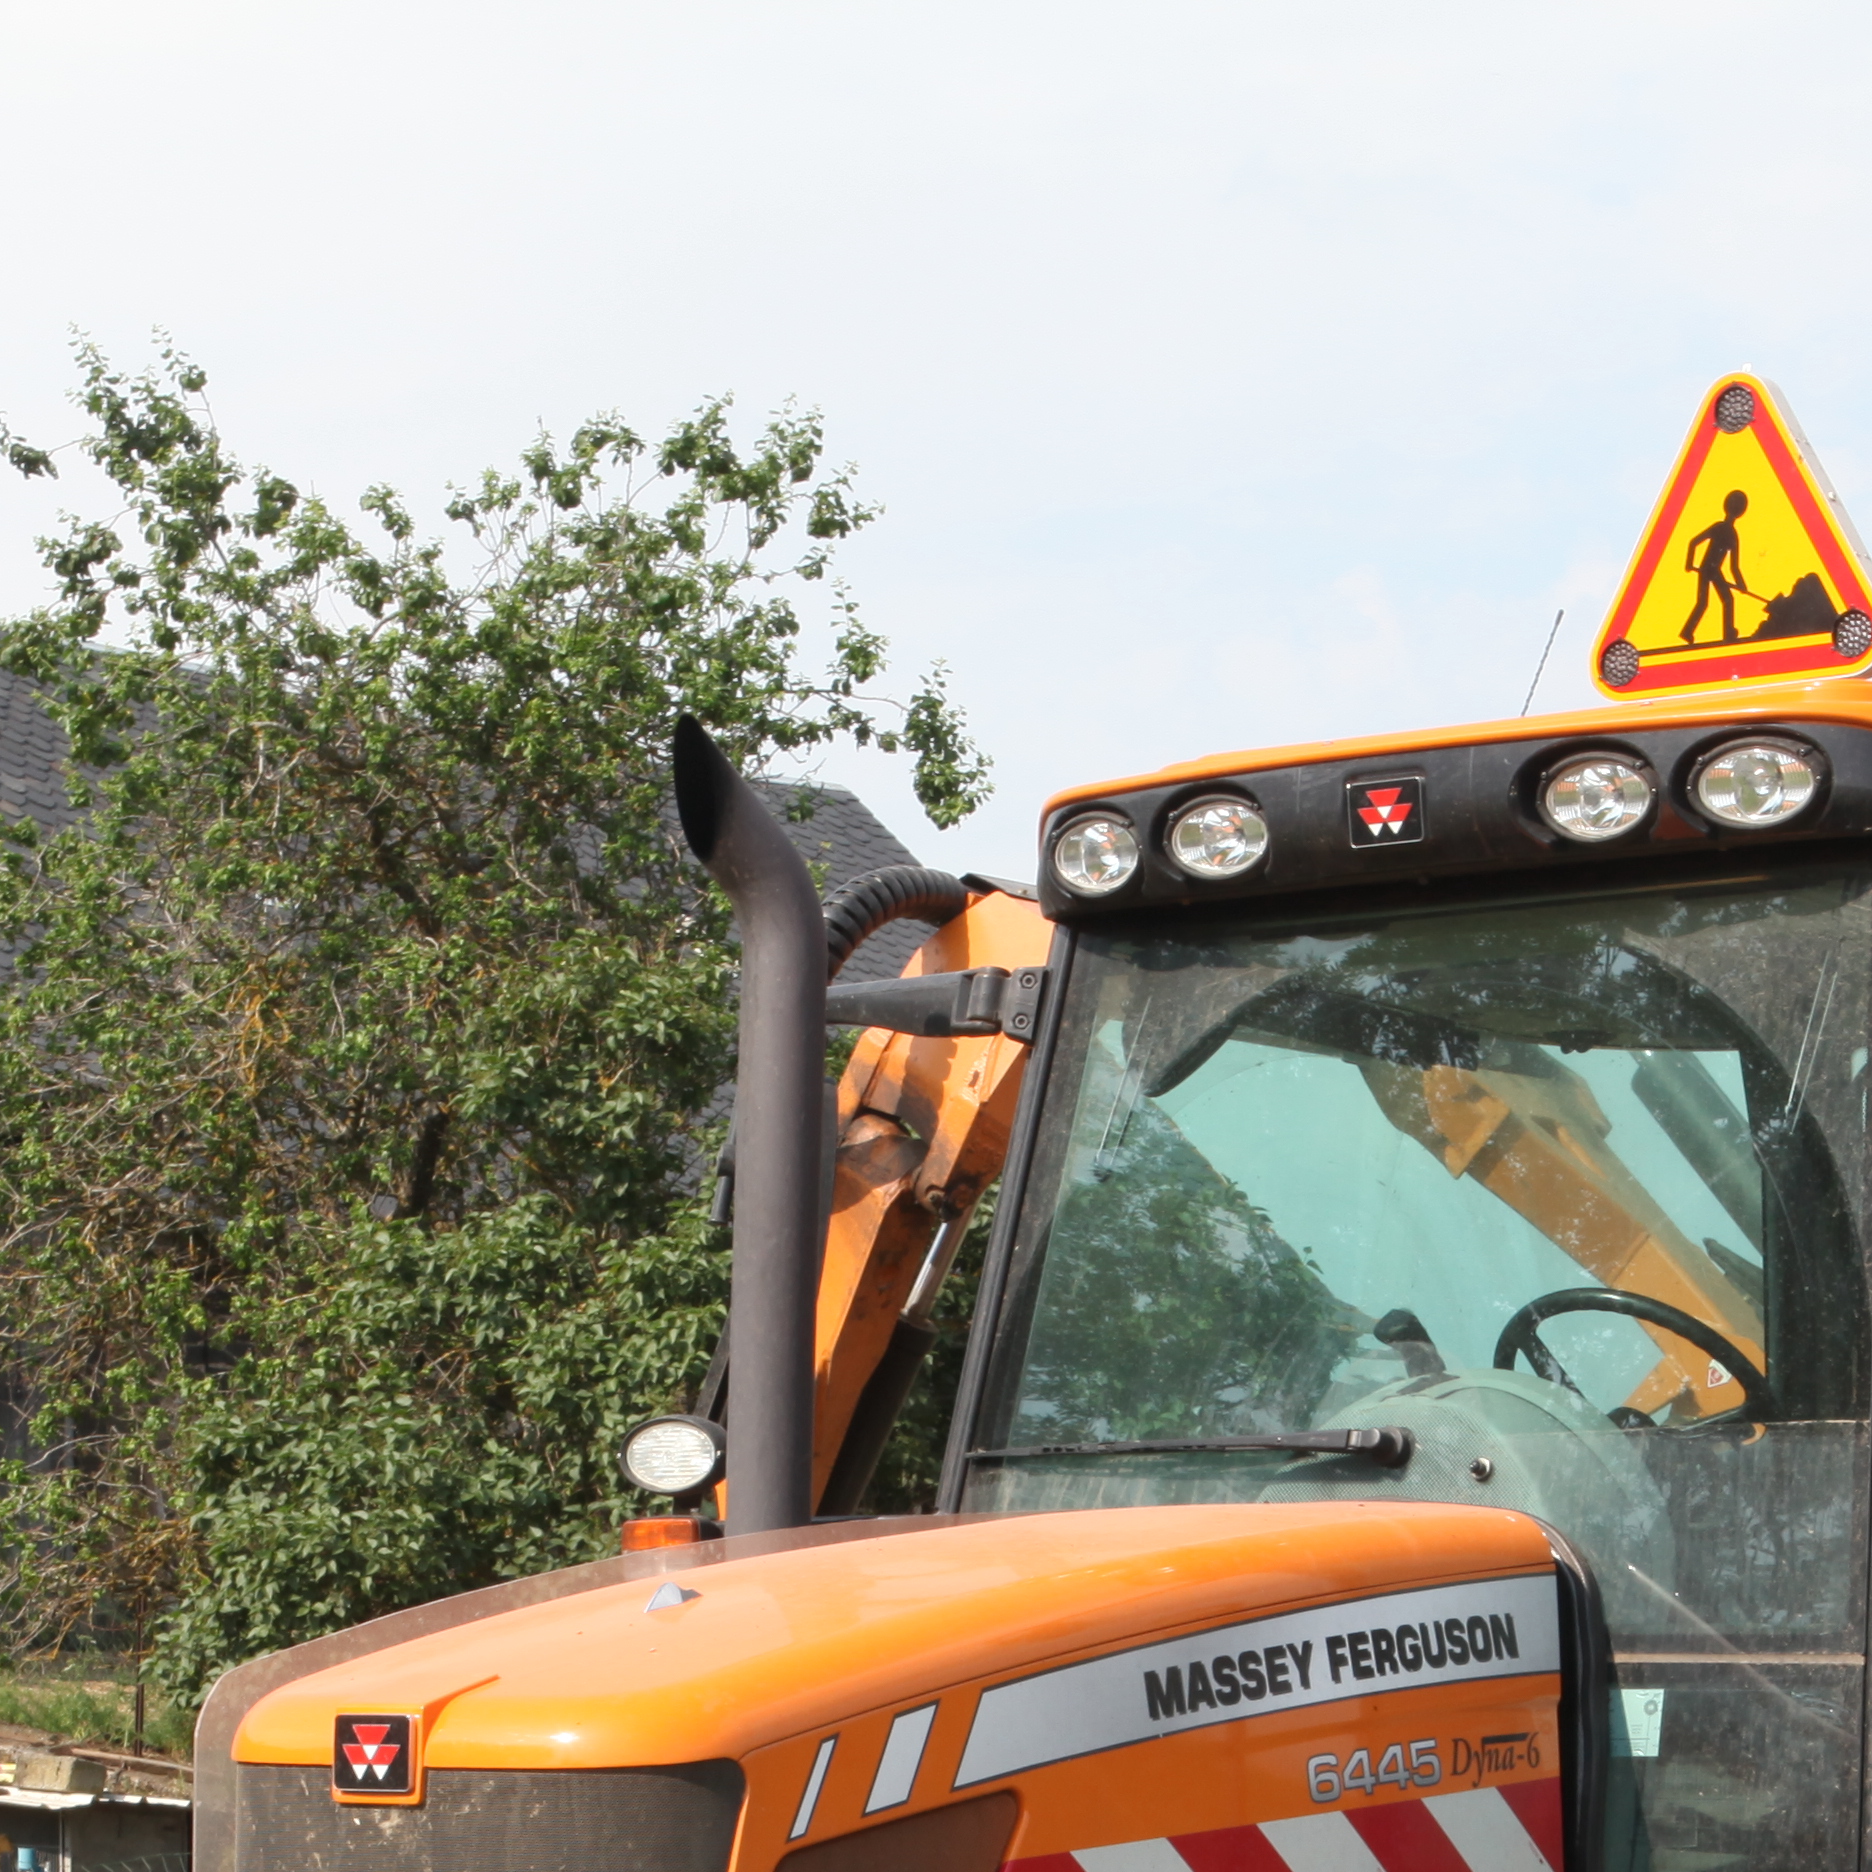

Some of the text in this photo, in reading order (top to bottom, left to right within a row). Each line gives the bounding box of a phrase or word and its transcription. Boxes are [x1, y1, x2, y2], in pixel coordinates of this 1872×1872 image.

[1143, 1612, 1520, 1721] MASSEY FERGUSON
[1307, 1731, 1540, 1804] 6445 Dyna-6
